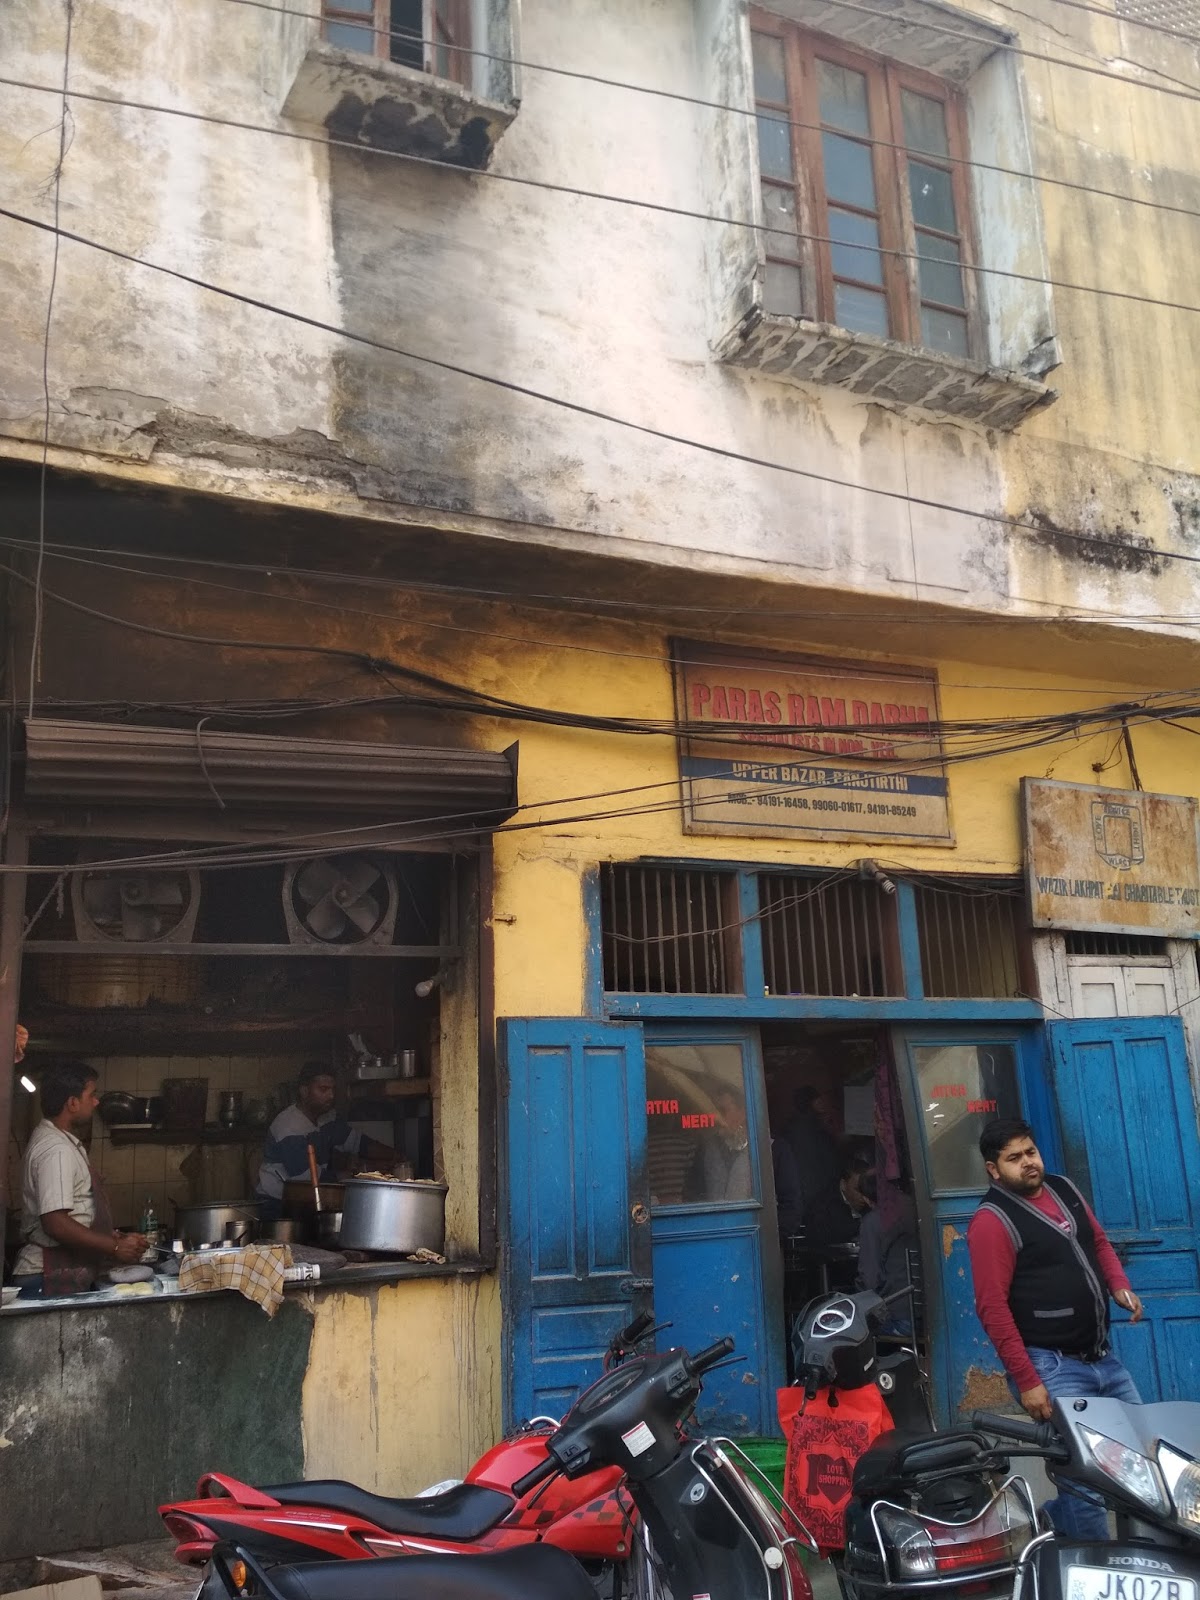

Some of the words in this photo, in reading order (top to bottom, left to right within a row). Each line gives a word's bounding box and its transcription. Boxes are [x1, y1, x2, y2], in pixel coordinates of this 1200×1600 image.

[692, 683, 782, 724] PARAS
[787, 694, 848, 727] RAM
[733, 763, 778, 780] UPPER
[834, 771, 908, 791] PANJTIRTHI
[682, 1114, 716, 1128] MEAT
[827, 1464, 844, 1475] LOVE
[1107, 1556, 1176, 1574] HONDA
